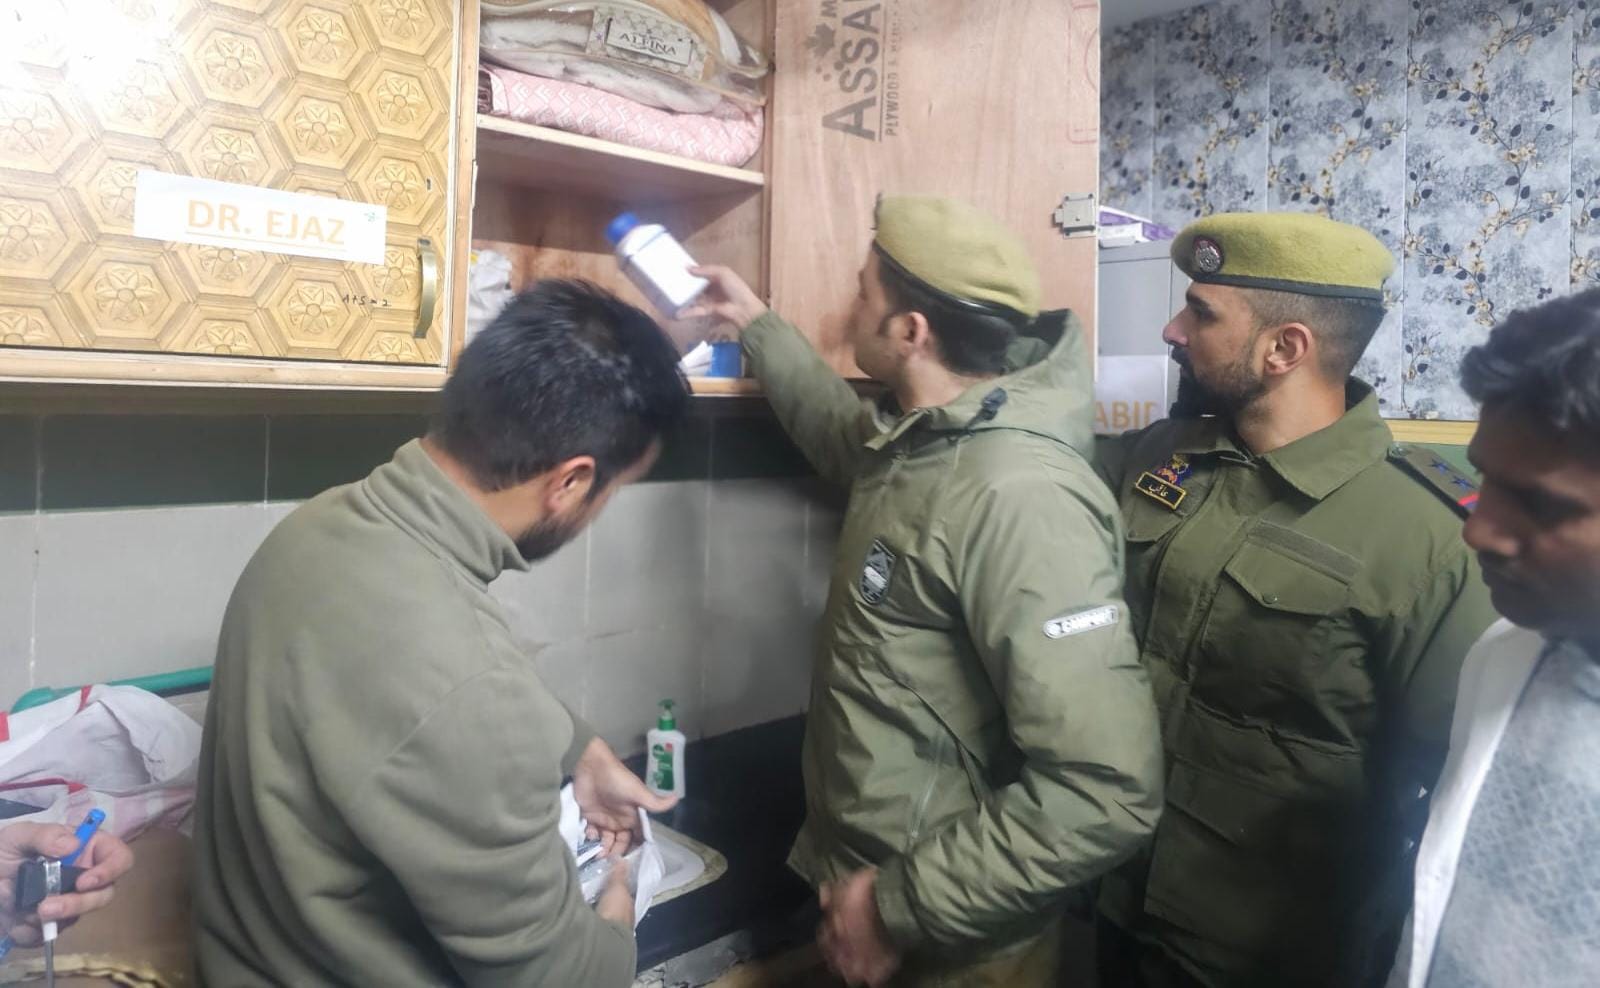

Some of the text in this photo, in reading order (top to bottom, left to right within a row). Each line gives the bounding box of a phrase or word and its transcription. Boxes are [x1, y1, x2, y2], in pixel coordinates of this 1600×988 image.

[821, 0, 881, 141] ASSA
[885, 71, 899, 136] PLYWOOD
[187, 200, 344, 245] DR. EJAZ
